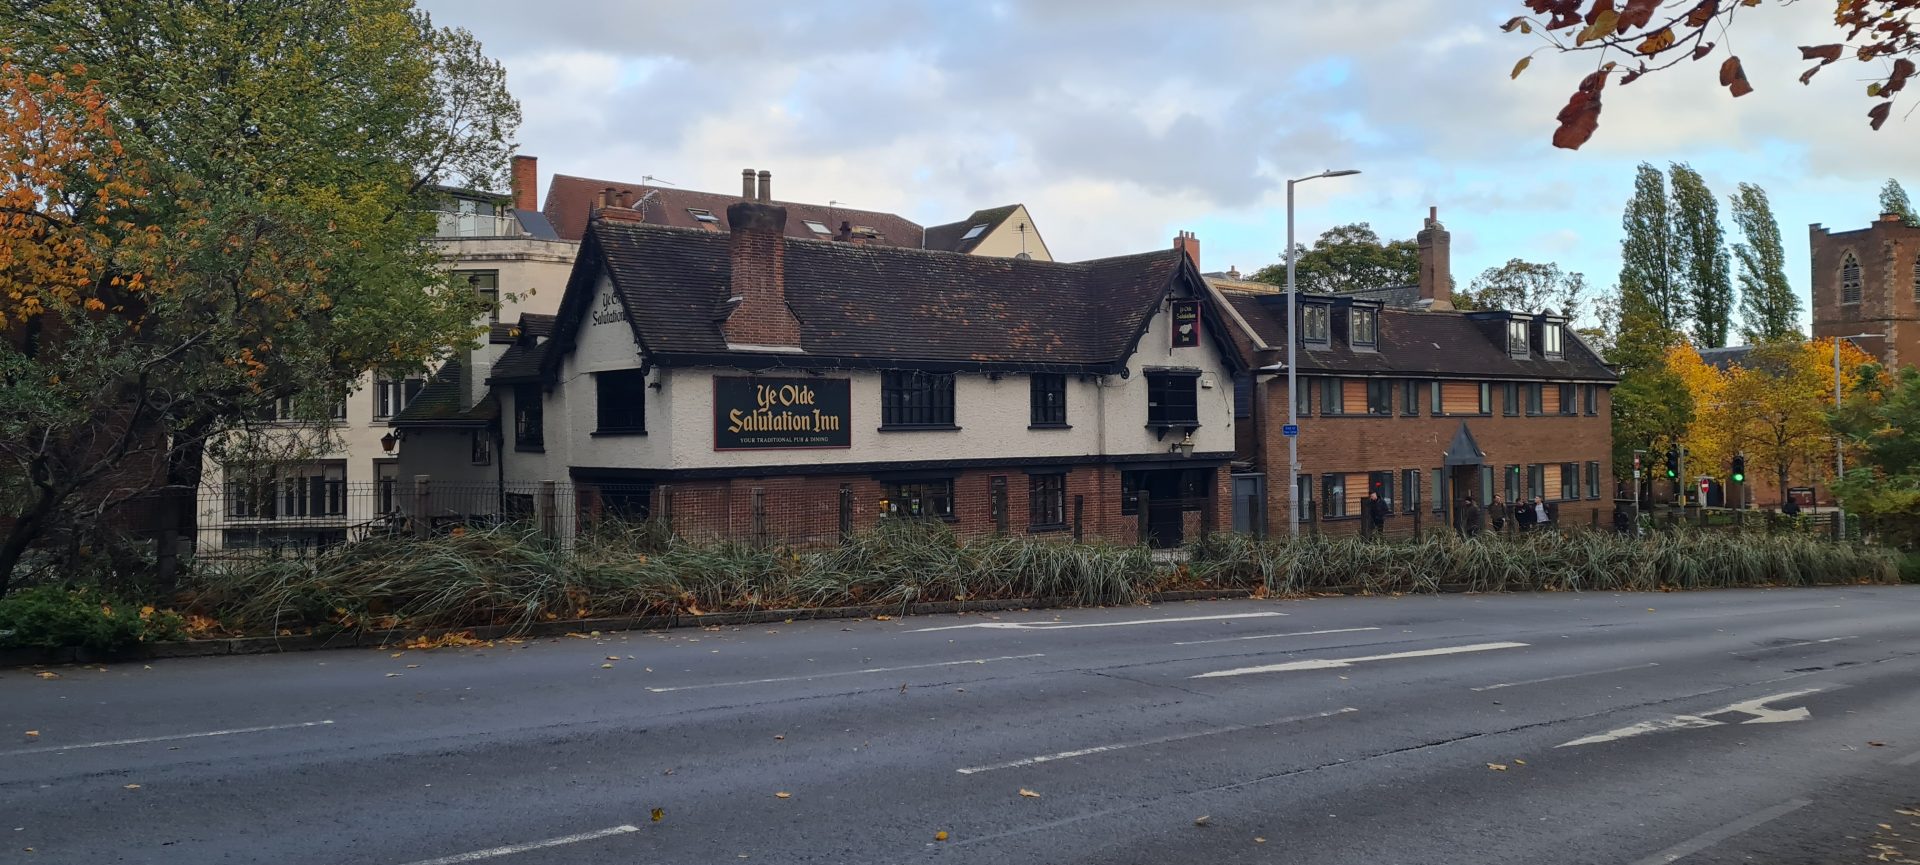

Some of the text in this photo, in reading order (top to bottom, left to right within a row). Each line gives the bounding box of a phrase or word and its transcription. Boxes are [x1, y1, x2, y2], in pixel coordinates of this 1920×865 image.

[603, 293, 610, 311] Ye
[757, 384, 815, 413] Ye Olde
[728, 408, 840, 433] Salutation Inn
